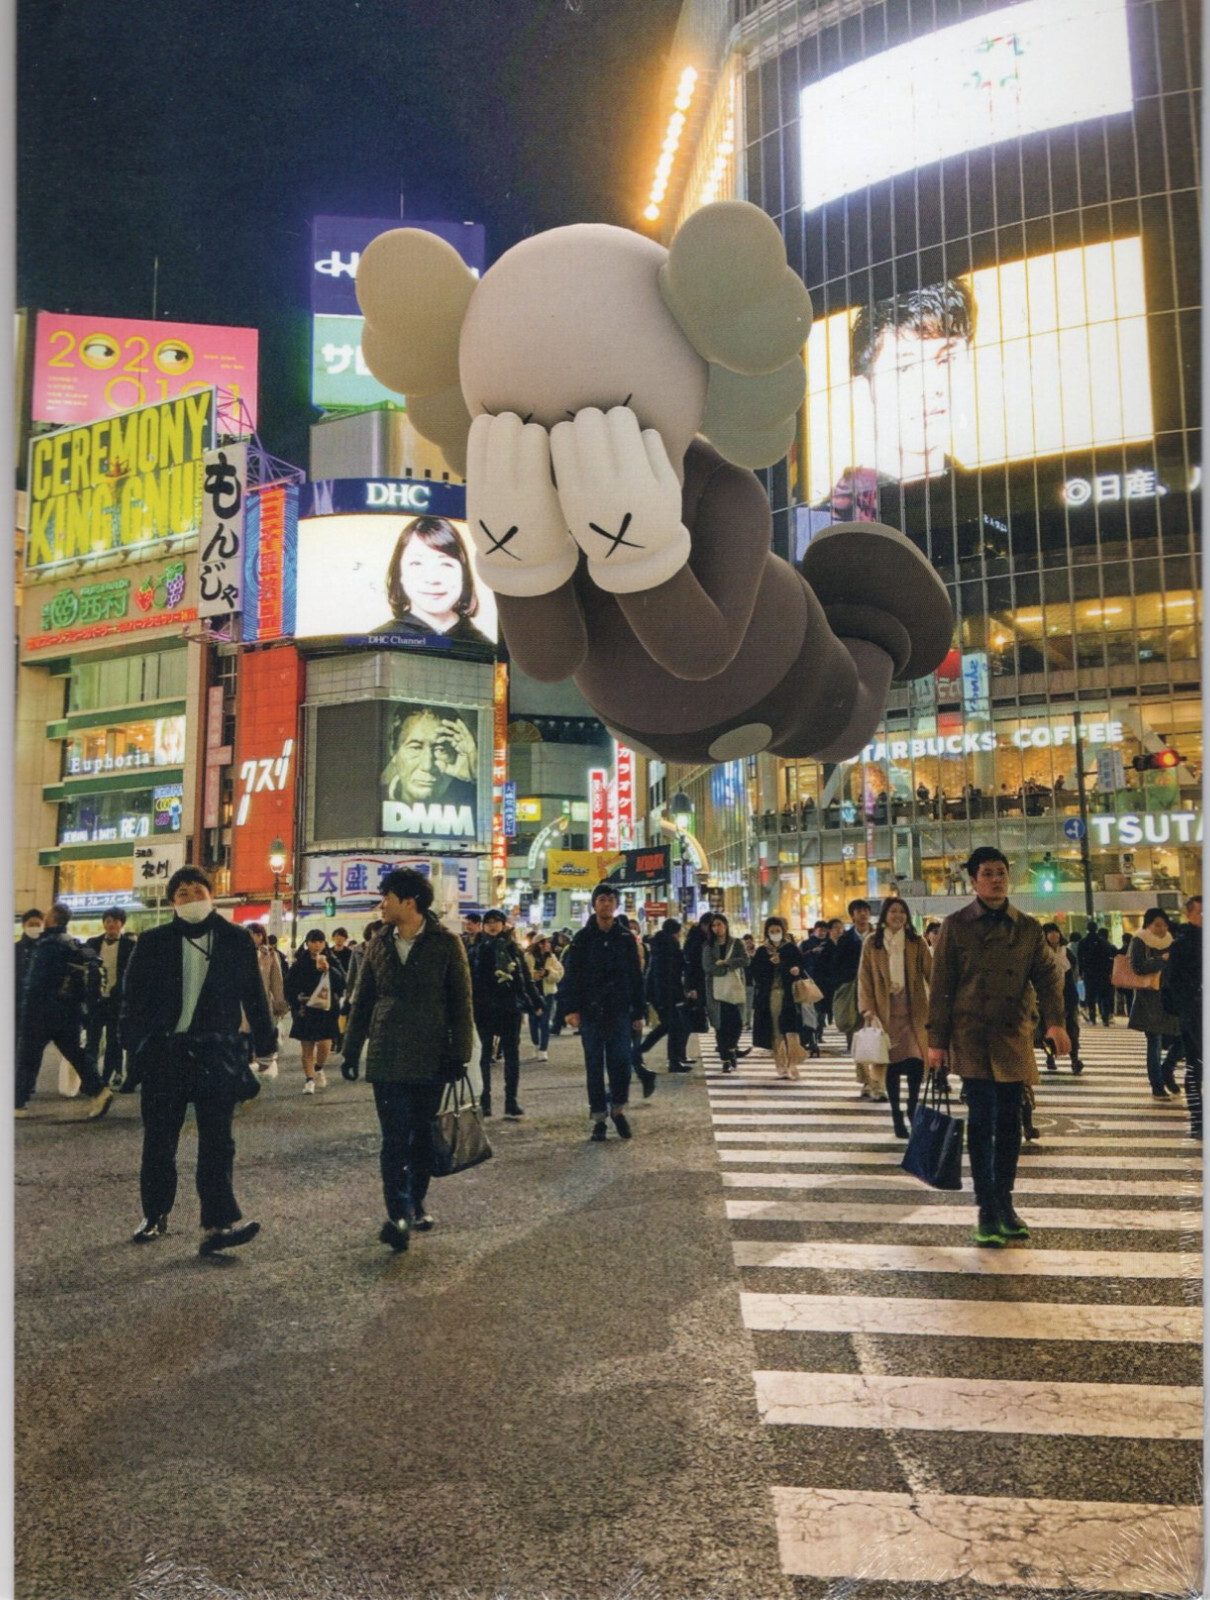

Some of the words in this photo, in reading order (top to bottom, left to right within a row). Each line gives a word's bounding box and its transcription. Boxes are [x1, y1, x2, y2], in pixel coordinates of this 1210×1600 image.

[47, 329, 196, 377] 2020
[33, 391, 211, 501] CEREMONY
[366, 481, 433, 507] DHC
[29, 480, 114, 568] KING
[120, 459, 195, 546] GNU
[200, 451, 242, 609] もんじゃ
[367, 635, 390, 645] DHC
[390, 636, 427, 646] Channel
[70, 748, 150, 775] Euphoria
[843, 732, 998, 766] TARBUCKS
[382, 800, 475, 837] DMM
